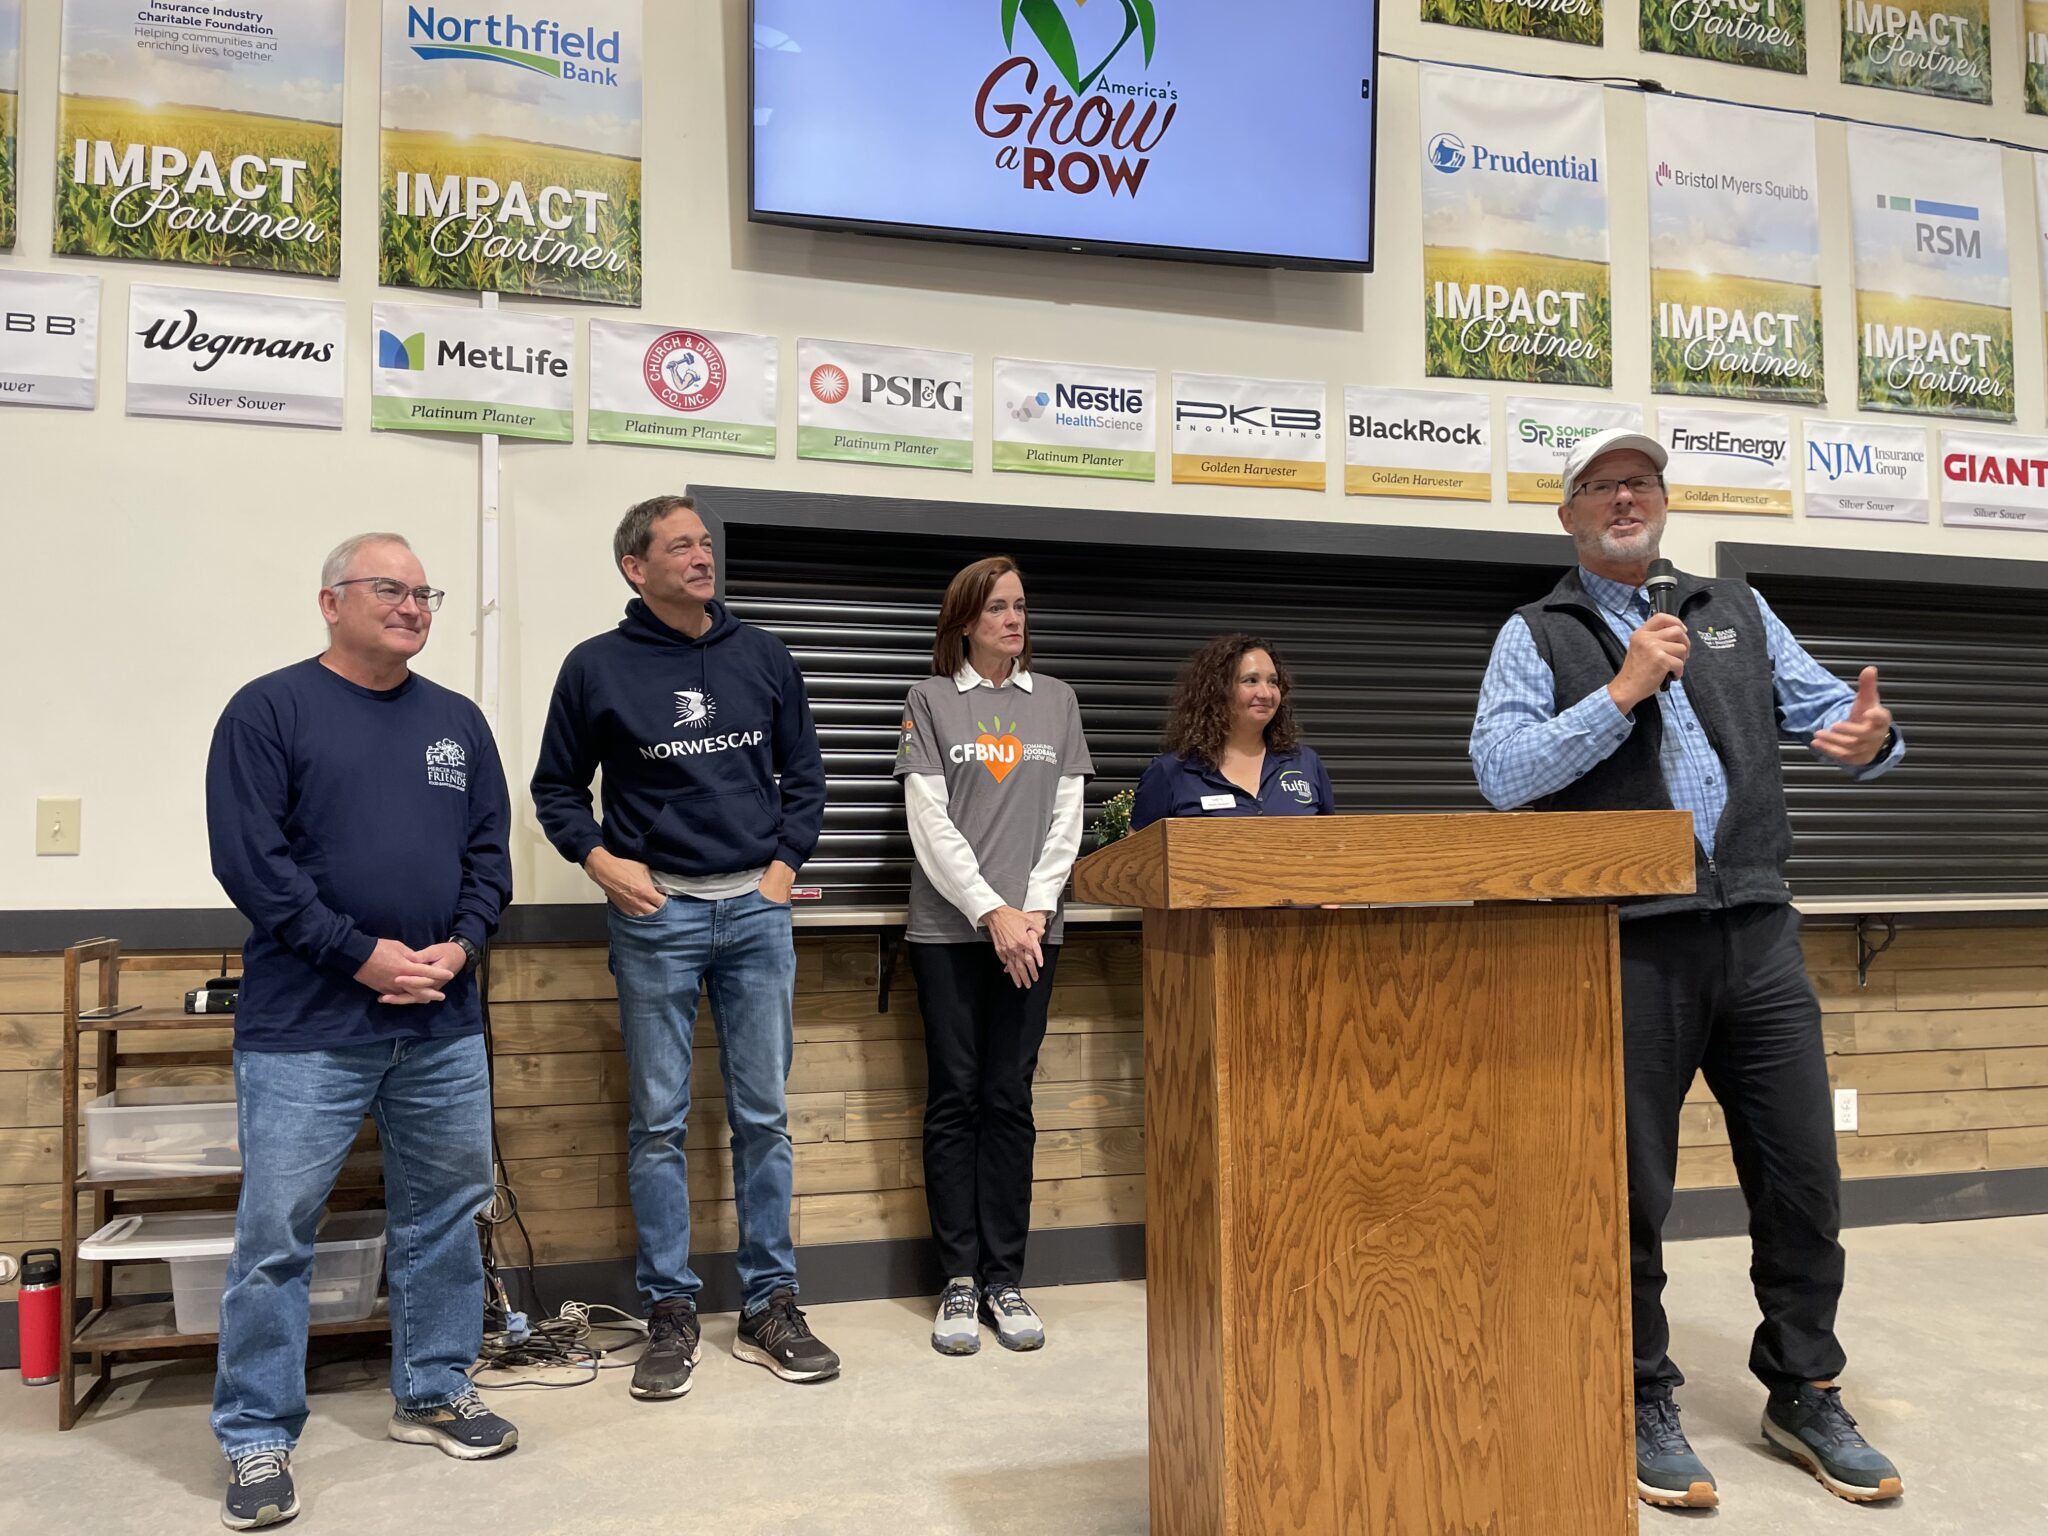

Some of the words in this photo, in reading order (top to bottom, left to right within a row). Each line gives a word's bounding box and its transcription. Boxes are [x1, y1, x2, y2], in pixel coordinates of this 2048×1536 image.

[138, 11, 202, 27] Charitable
[205, 18, 273, 36] Foundation
[151, 0, 210, 15] Insurance
[213, 6, 263, 23] Industry
[1670, 0, 1796, 47] Partner
[1847, 0, 1969, 49] IMPACT
[134, 26, 179, 41] Helping
[182, 32, 253, 48] communities
[255, 41, 278, 51] and
[408, 5, 620, 64] Northfield
[137, 40, 189, 54] enriching
[192, 43, 219, 57] lives,
[223, 48, 273, 62] together.
[1868, 32, 1983, 78] Partner
[563, 61, 618, 87] Bank
[1096, 74, 1178, 100] America's
[975, 56, 1177, 153] Grow
[74, 138, 307, 204] IMPACT
[995, 146, 1020, 170] a
[1023, 146, 1150, 199] ROW
[1472, 144, 1599, 182] Prudential
[1675, 170, 1718, 190] Bristol
[1721, 175, 1763, 195] Myers
[1765, 181, 1809, 201] Squibb
[110, 181, 325, 243] Partner
[396, 171, 608, 234] IMPACT
[430, 212, 626, 272] Partner
[1915, 222, 1981, 259] RSM
[1434, 281, 1586, 328] IMPACT
[135, 309, 334, 372] Wegmans
[1460, 314, 1600, 360] Partner
[1659, 302, 1800, 348] IMPACT
[437, 340, 569, 378] MetLife
[1684, 335, 1814, 379] Partner
[1863, 322, 1992, 368] IMPACT
[648, 336, 682, 382] CHURCH
[684, 337, 693, 348] &
[696, 341, 722, 390] DWIGHT
[1887, 354, 2006, 397] Partner
[188, 392, 233, 408] Silver
[236, 395, 287, 411] Sower
[411, 404, 478, 422] Platinum
[482, 408, 536, 427] Planter
[1176, 400, 1321, 431] PKB
[624, 419, 688, 438] Platinum
[692, 424, 742, 443] Planter
[1055, 412, 1143, 432] HealthScience
[1176, 424, 1321, 439] ENGINEERING
[1349, 414, 1482, 445] BlackRock
[833, 435, 891, 452] Platinum
[893, 440, 939, 456] Planter
[1026, 448, 1079, 464] Platinum
[1081, 452, 1124, 467] Planter
[1671, 428, 1785, 461] FirstEnergy
[1874, 447, 1925, 463] Insurance
[1201, 461, 1241, 475] Golden
[1243, 463, 1297, 477] Harvester
[1807, 440, 1875, 481] NJM
[1876, 462, 1907, 480] Group
[1944, 453, 2048, 488] GIANT
[1372, 472, 1410, 485] Golden
[1412, 474, 1464, 488] Harvester
[1685, 490, 1720, 503] Golden
[1721, 492, 1769, 505] Harvester
[1839, 499, 1864, 510] Silver
[1867, 500, 1895, 511] Sower
[1973, 507, 1997, 518] Silver
[1999, 508, 2026, 520] Sower
[639, 730, 763, 760] NORWESCAP
[949, 741, 1015, 764] CFBNJ
[428, 772, 466, 787] FRIENDS
